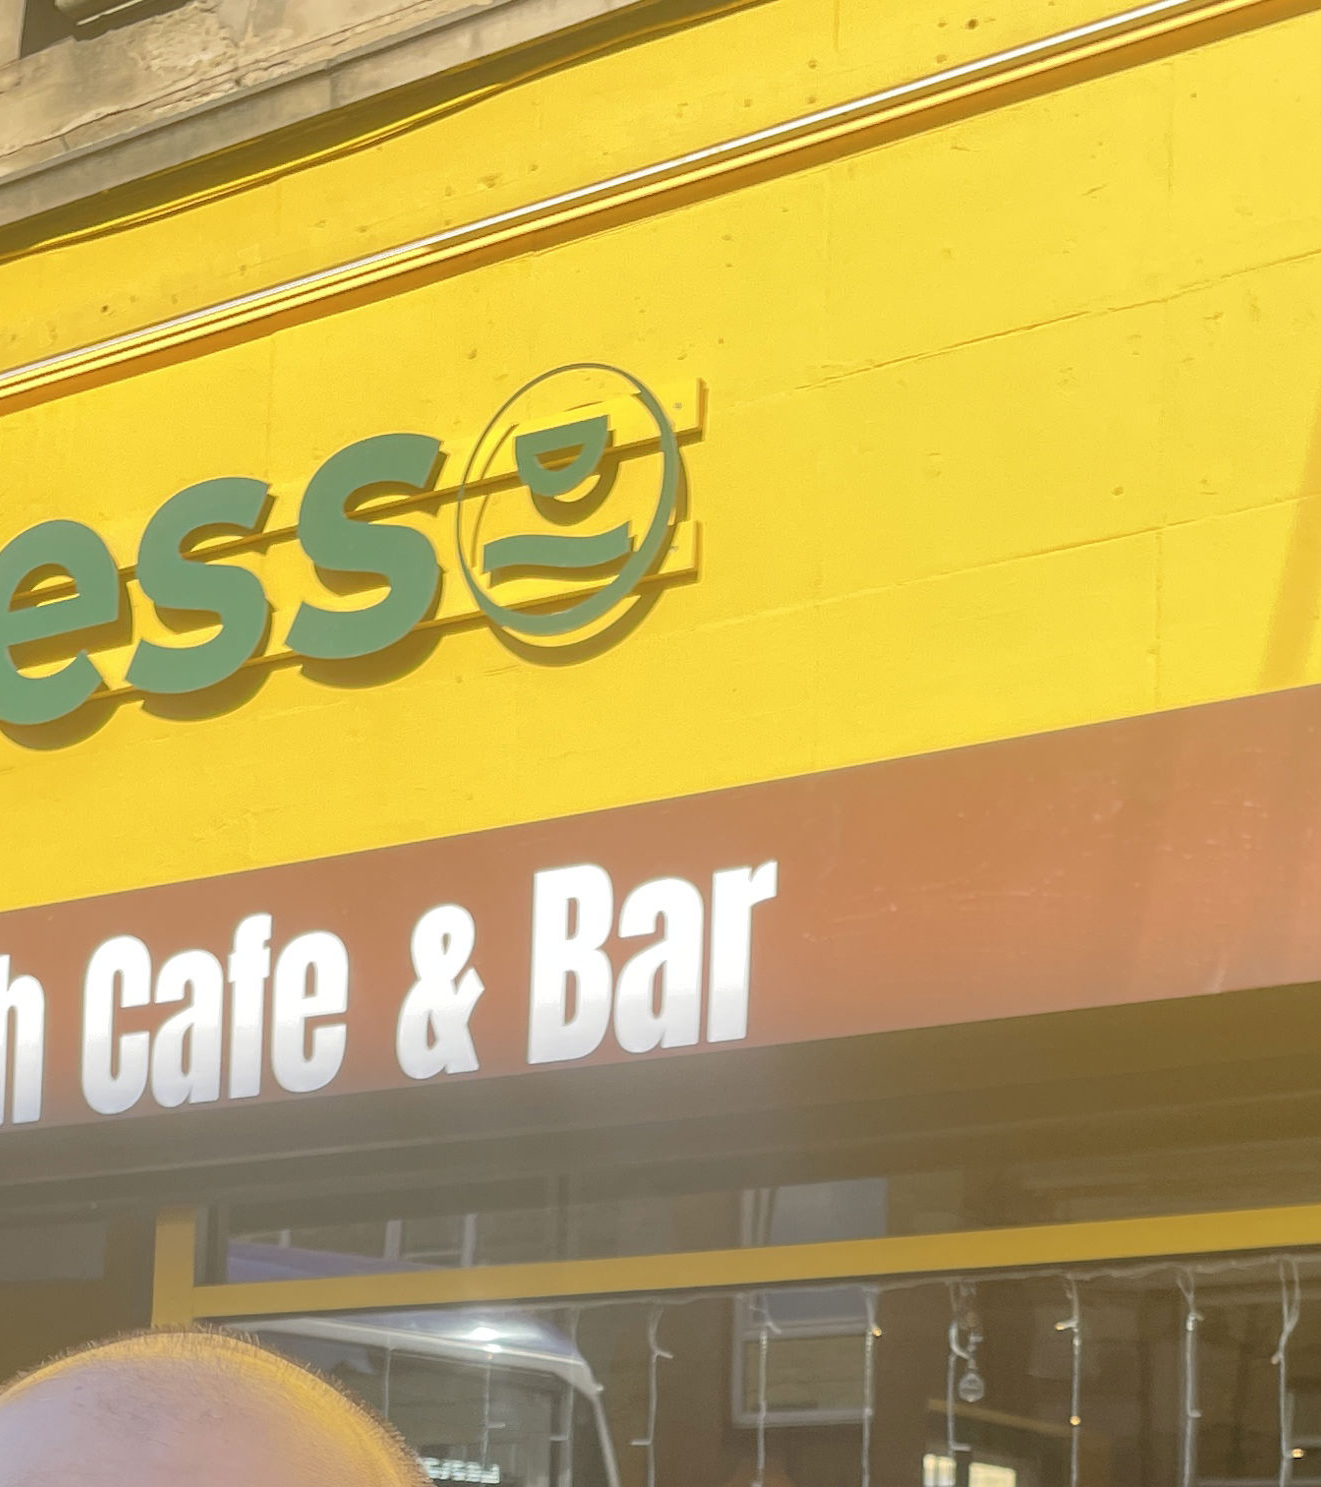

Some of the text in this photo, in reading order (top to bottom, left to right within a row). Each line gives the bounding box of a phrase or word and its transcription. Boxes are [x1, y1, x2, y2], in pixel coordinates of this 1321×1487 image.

[82, 912, 348, 1114] Cafe
[397, 904, 484, 1080] &
[528, 860, 777, 1067] Bar
